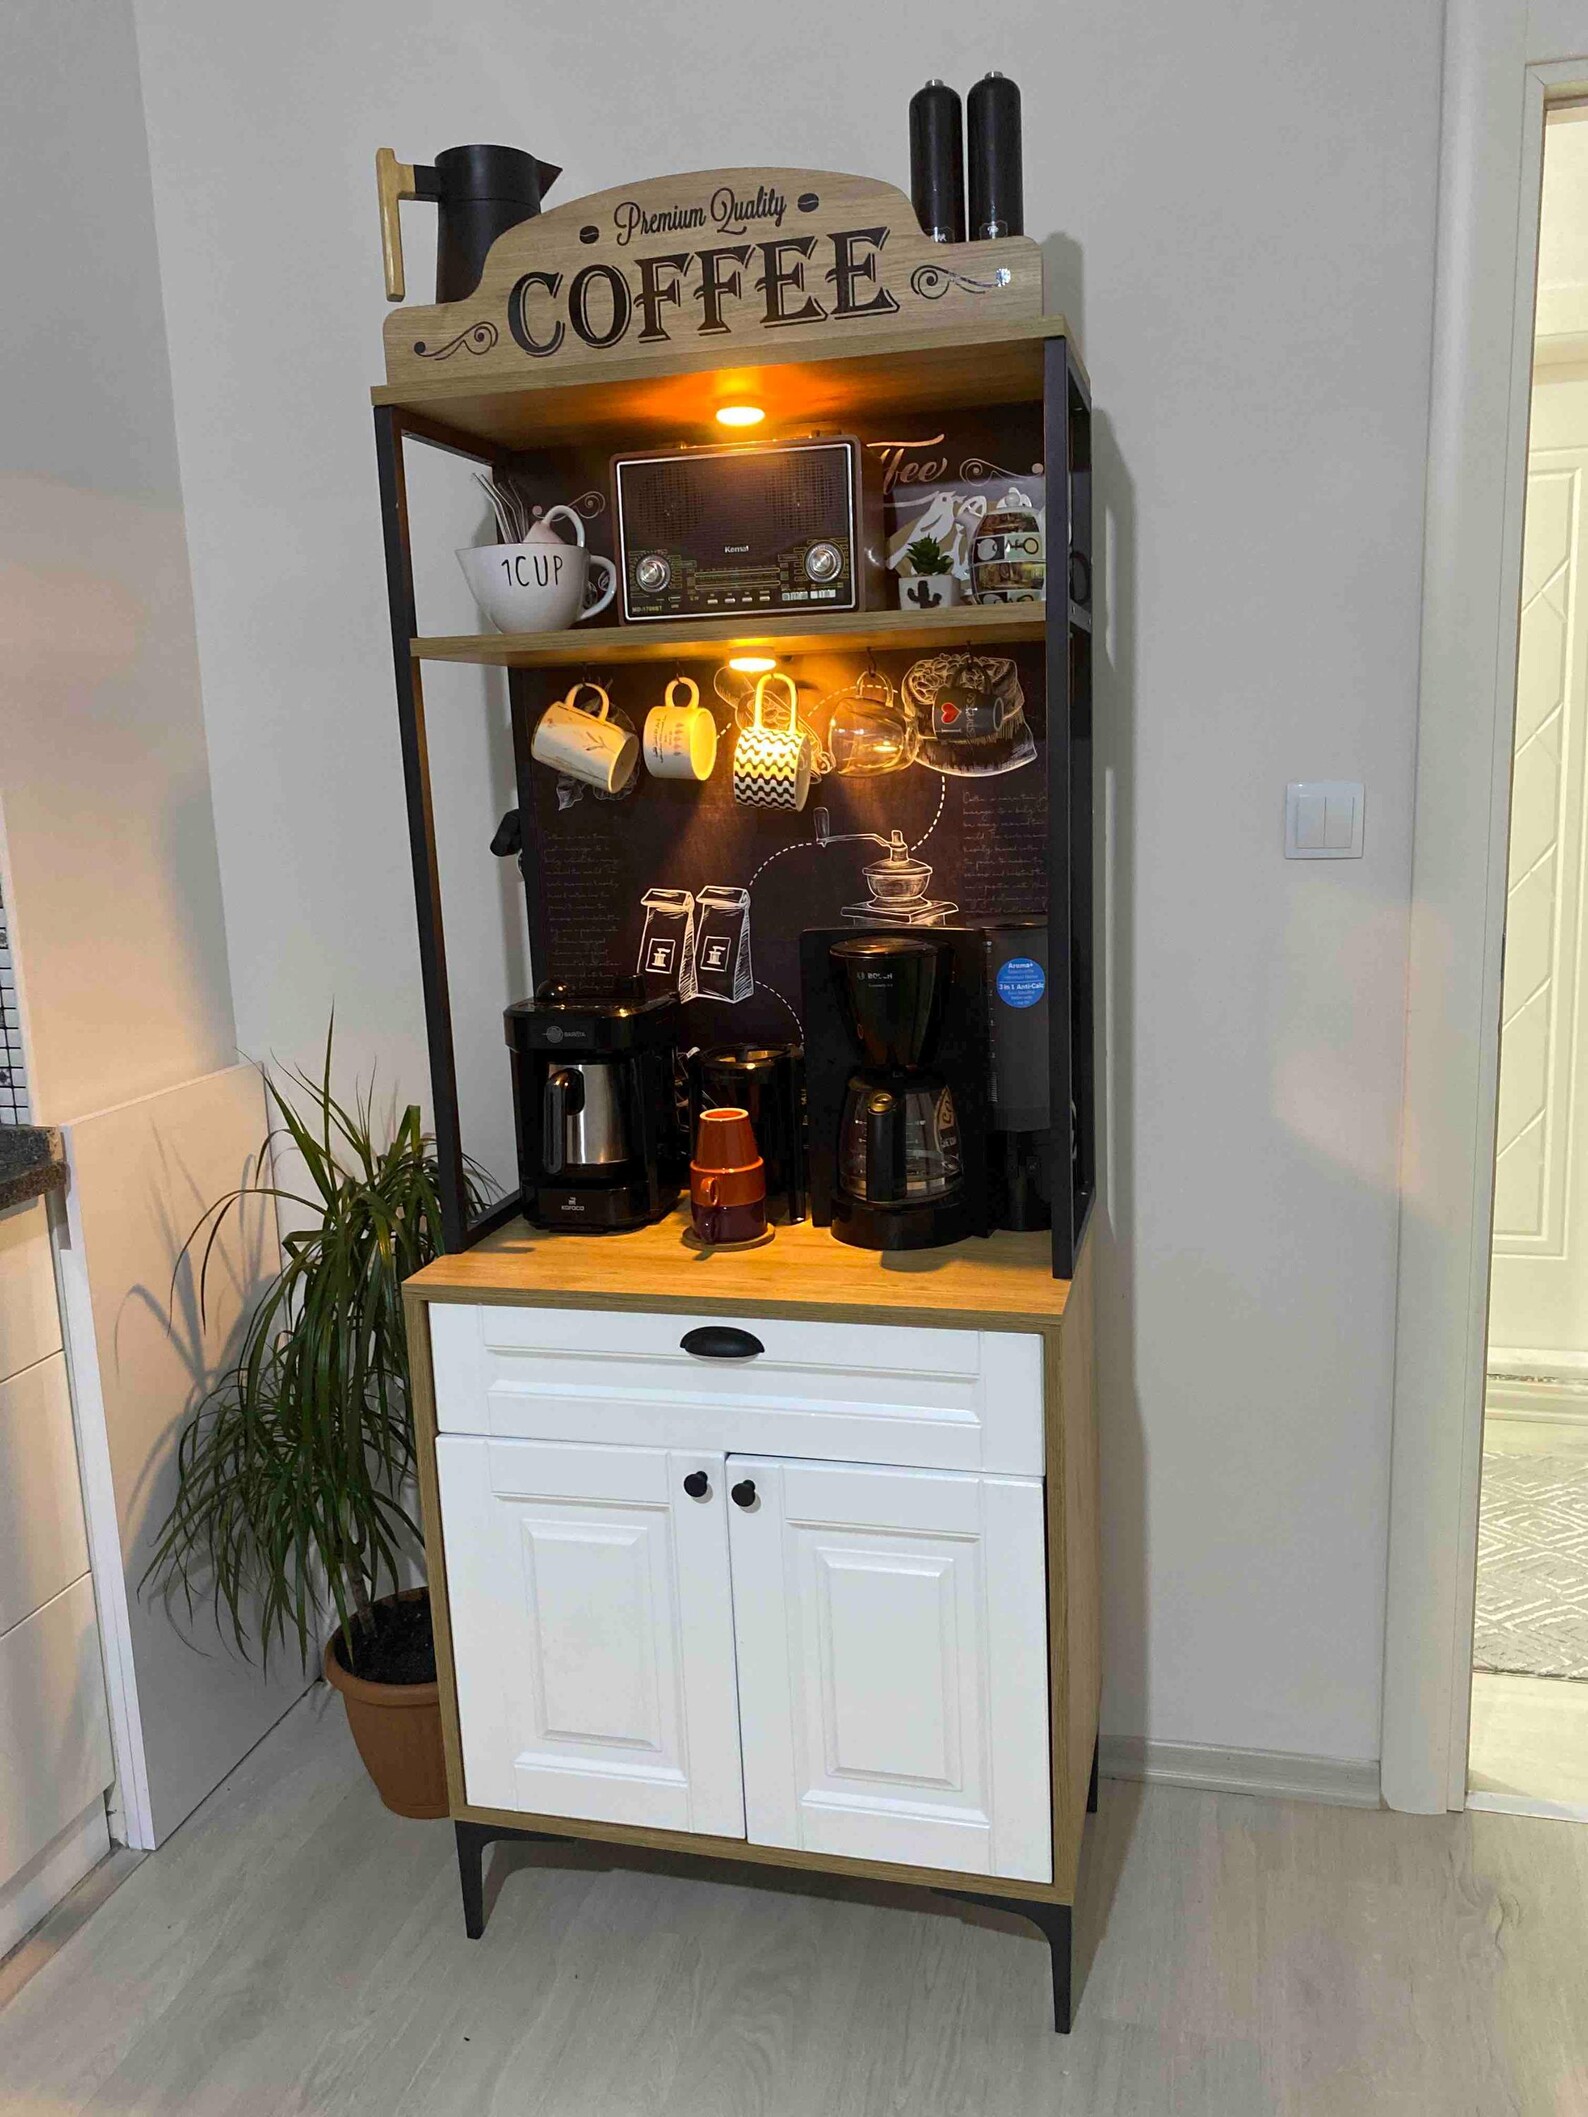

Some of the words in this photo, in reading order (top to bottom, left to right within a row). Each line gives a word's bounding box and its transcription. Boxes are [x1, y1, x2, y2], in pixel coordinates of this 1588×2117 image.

[614, 201, 707, 246] Premium
[710, 185, 787, 236] Quality
[507, 226, 900, 357] COFFEE
